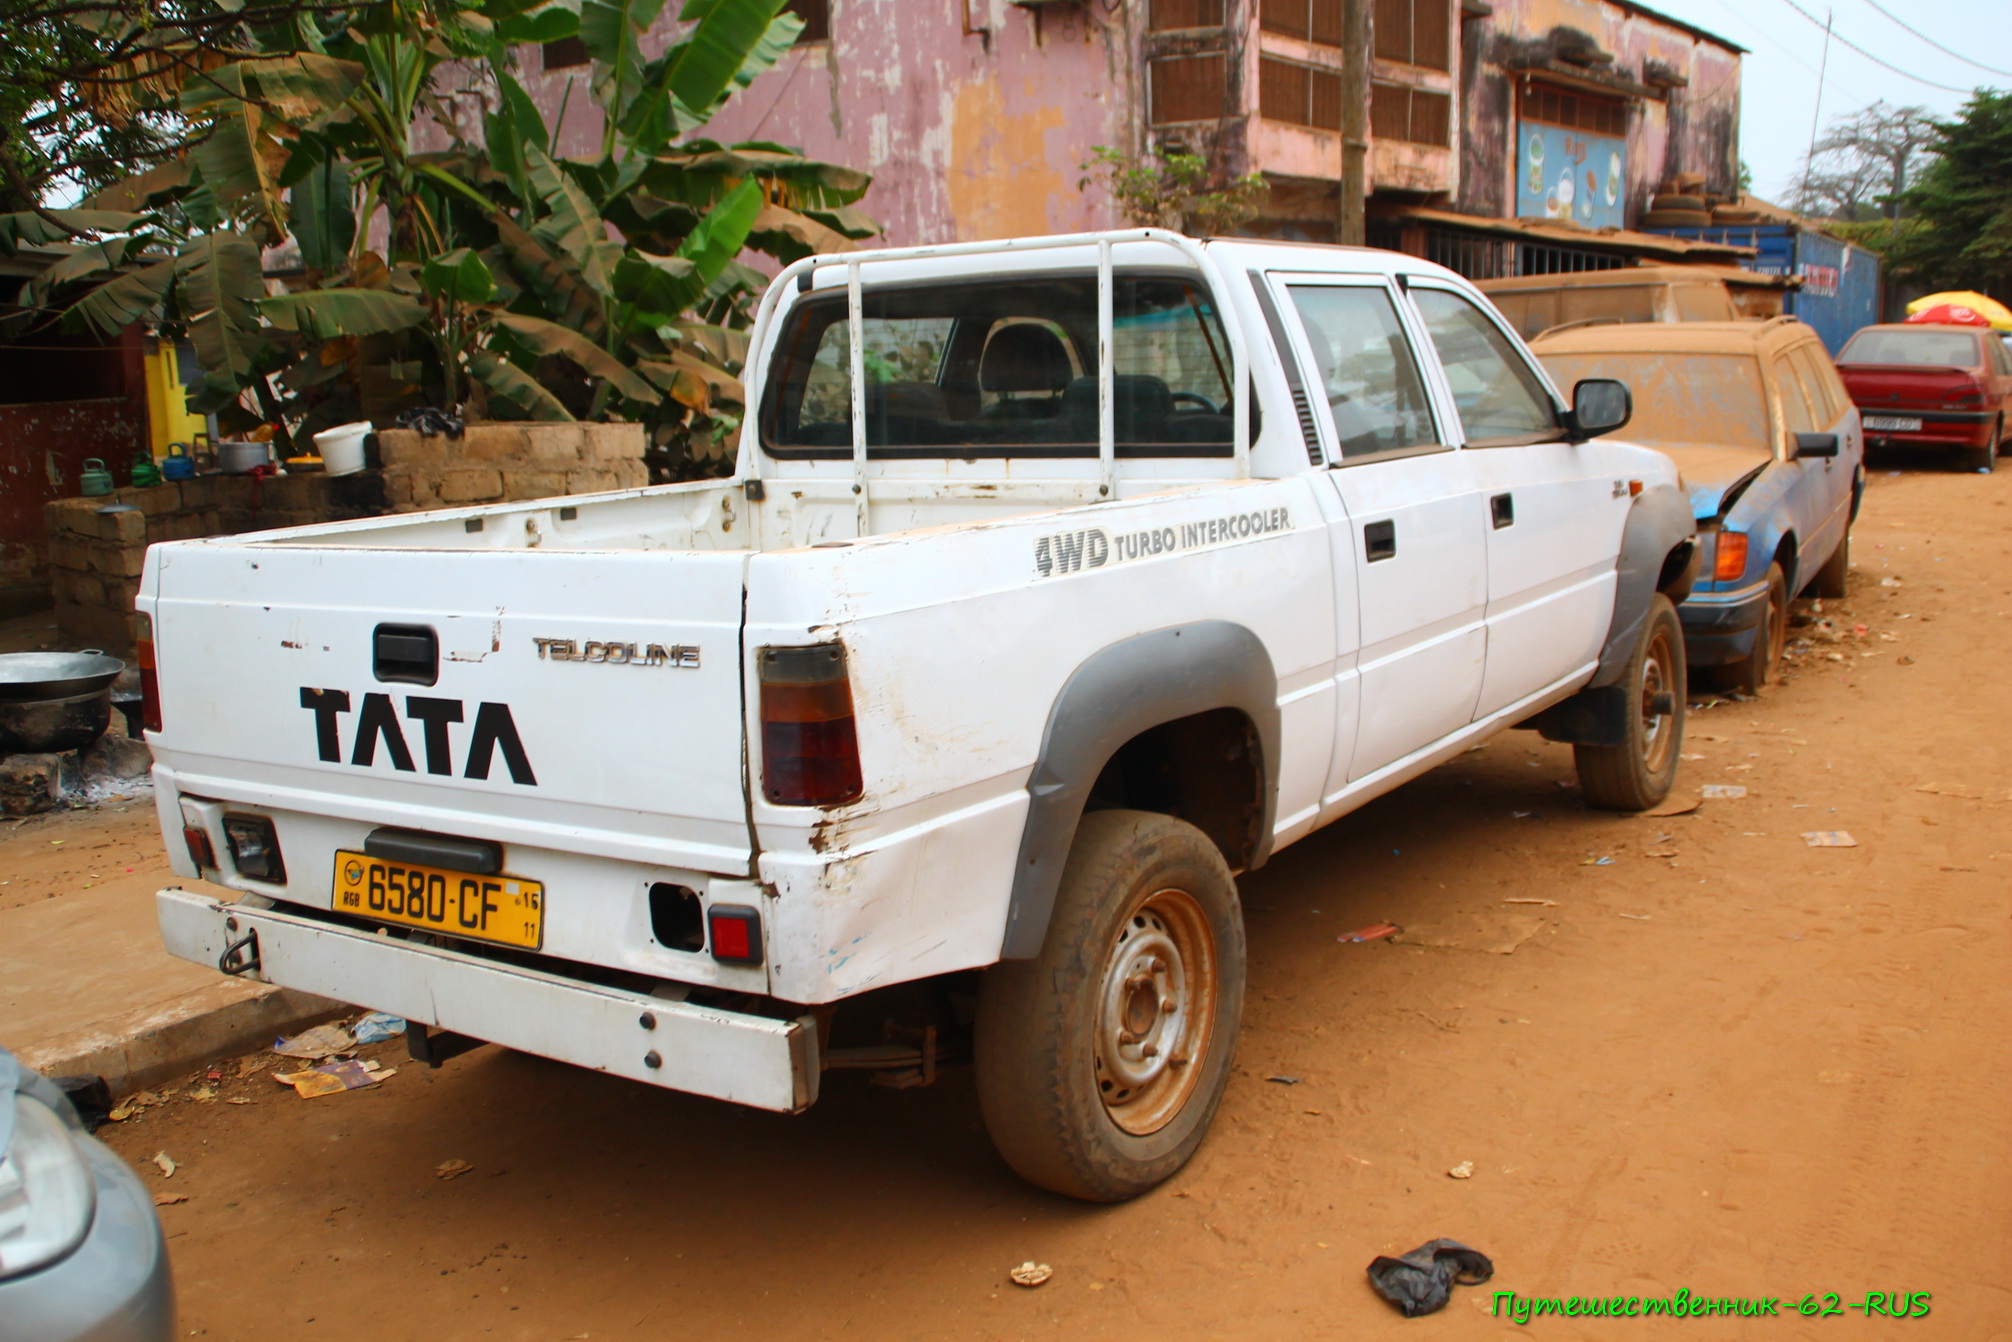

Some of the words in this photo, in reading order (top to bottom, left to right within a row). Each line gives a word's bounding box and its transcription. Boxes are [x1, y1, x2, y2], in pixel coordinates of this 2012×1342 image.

[1035, 528, 1109, 578] 4WD
[1114, 527, 1176, 562] TURBO
[1181, 507, 1291, 549] INTERCOOLER
[532, 636, 701, 669] TELCOLINE
[300, 686, 538, 786] TATA
[343, 891, 360, 908] RGB
[368, 864, 502, 931] 6580-CF
[523, 921, 536, 940] 11
